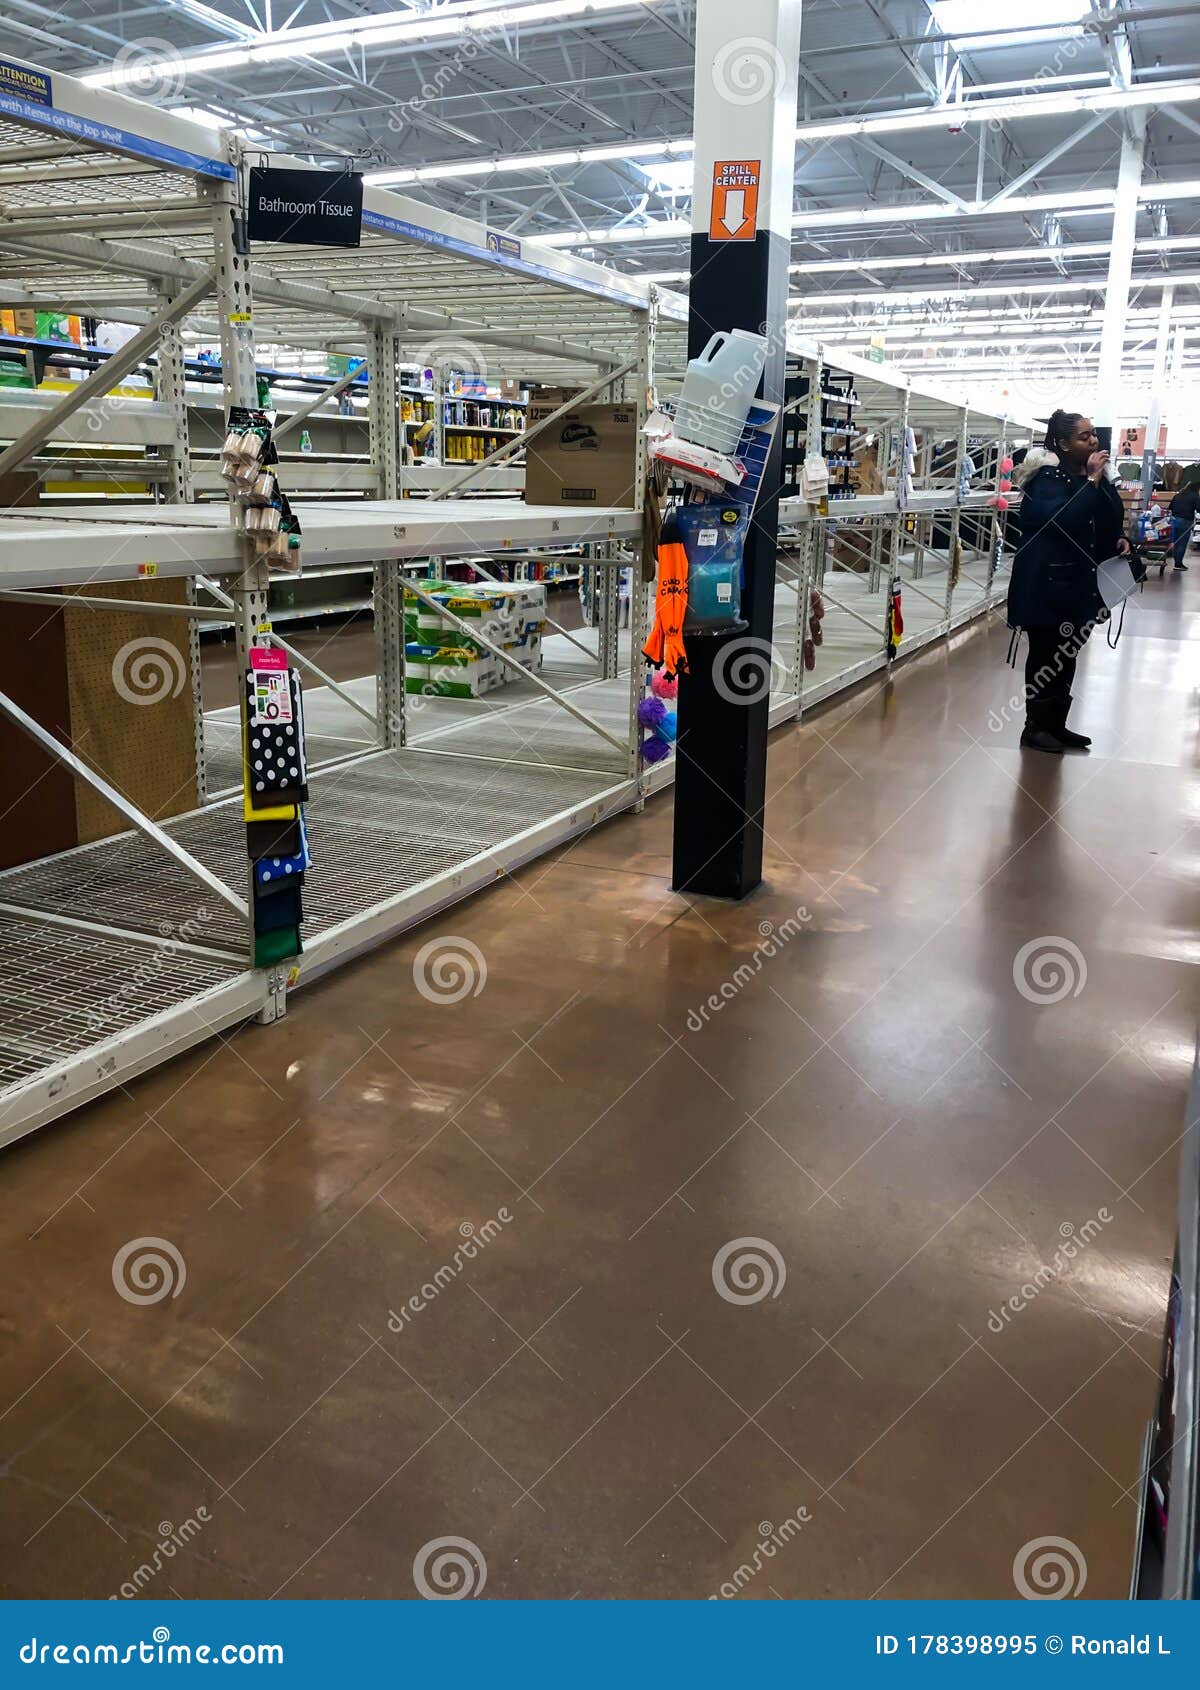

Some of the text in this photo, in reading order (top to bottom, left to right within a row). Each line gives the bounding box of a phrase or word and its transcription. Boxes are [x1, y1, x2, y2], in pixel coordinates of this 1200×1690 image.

[0, 65, 46, 89] TTENTION
[0, 99, 23, 112] with
[24, 104, 51, 121] items
[53, 115, 66, 125] on
[67, 117, 82, 131] the
[84, 124, 100, 137] top
[715, 175, 757, 186] CENTER
[722, 165, 751, 175] SPILL
[258, 196, 354, 217] Bathroom Tissue
